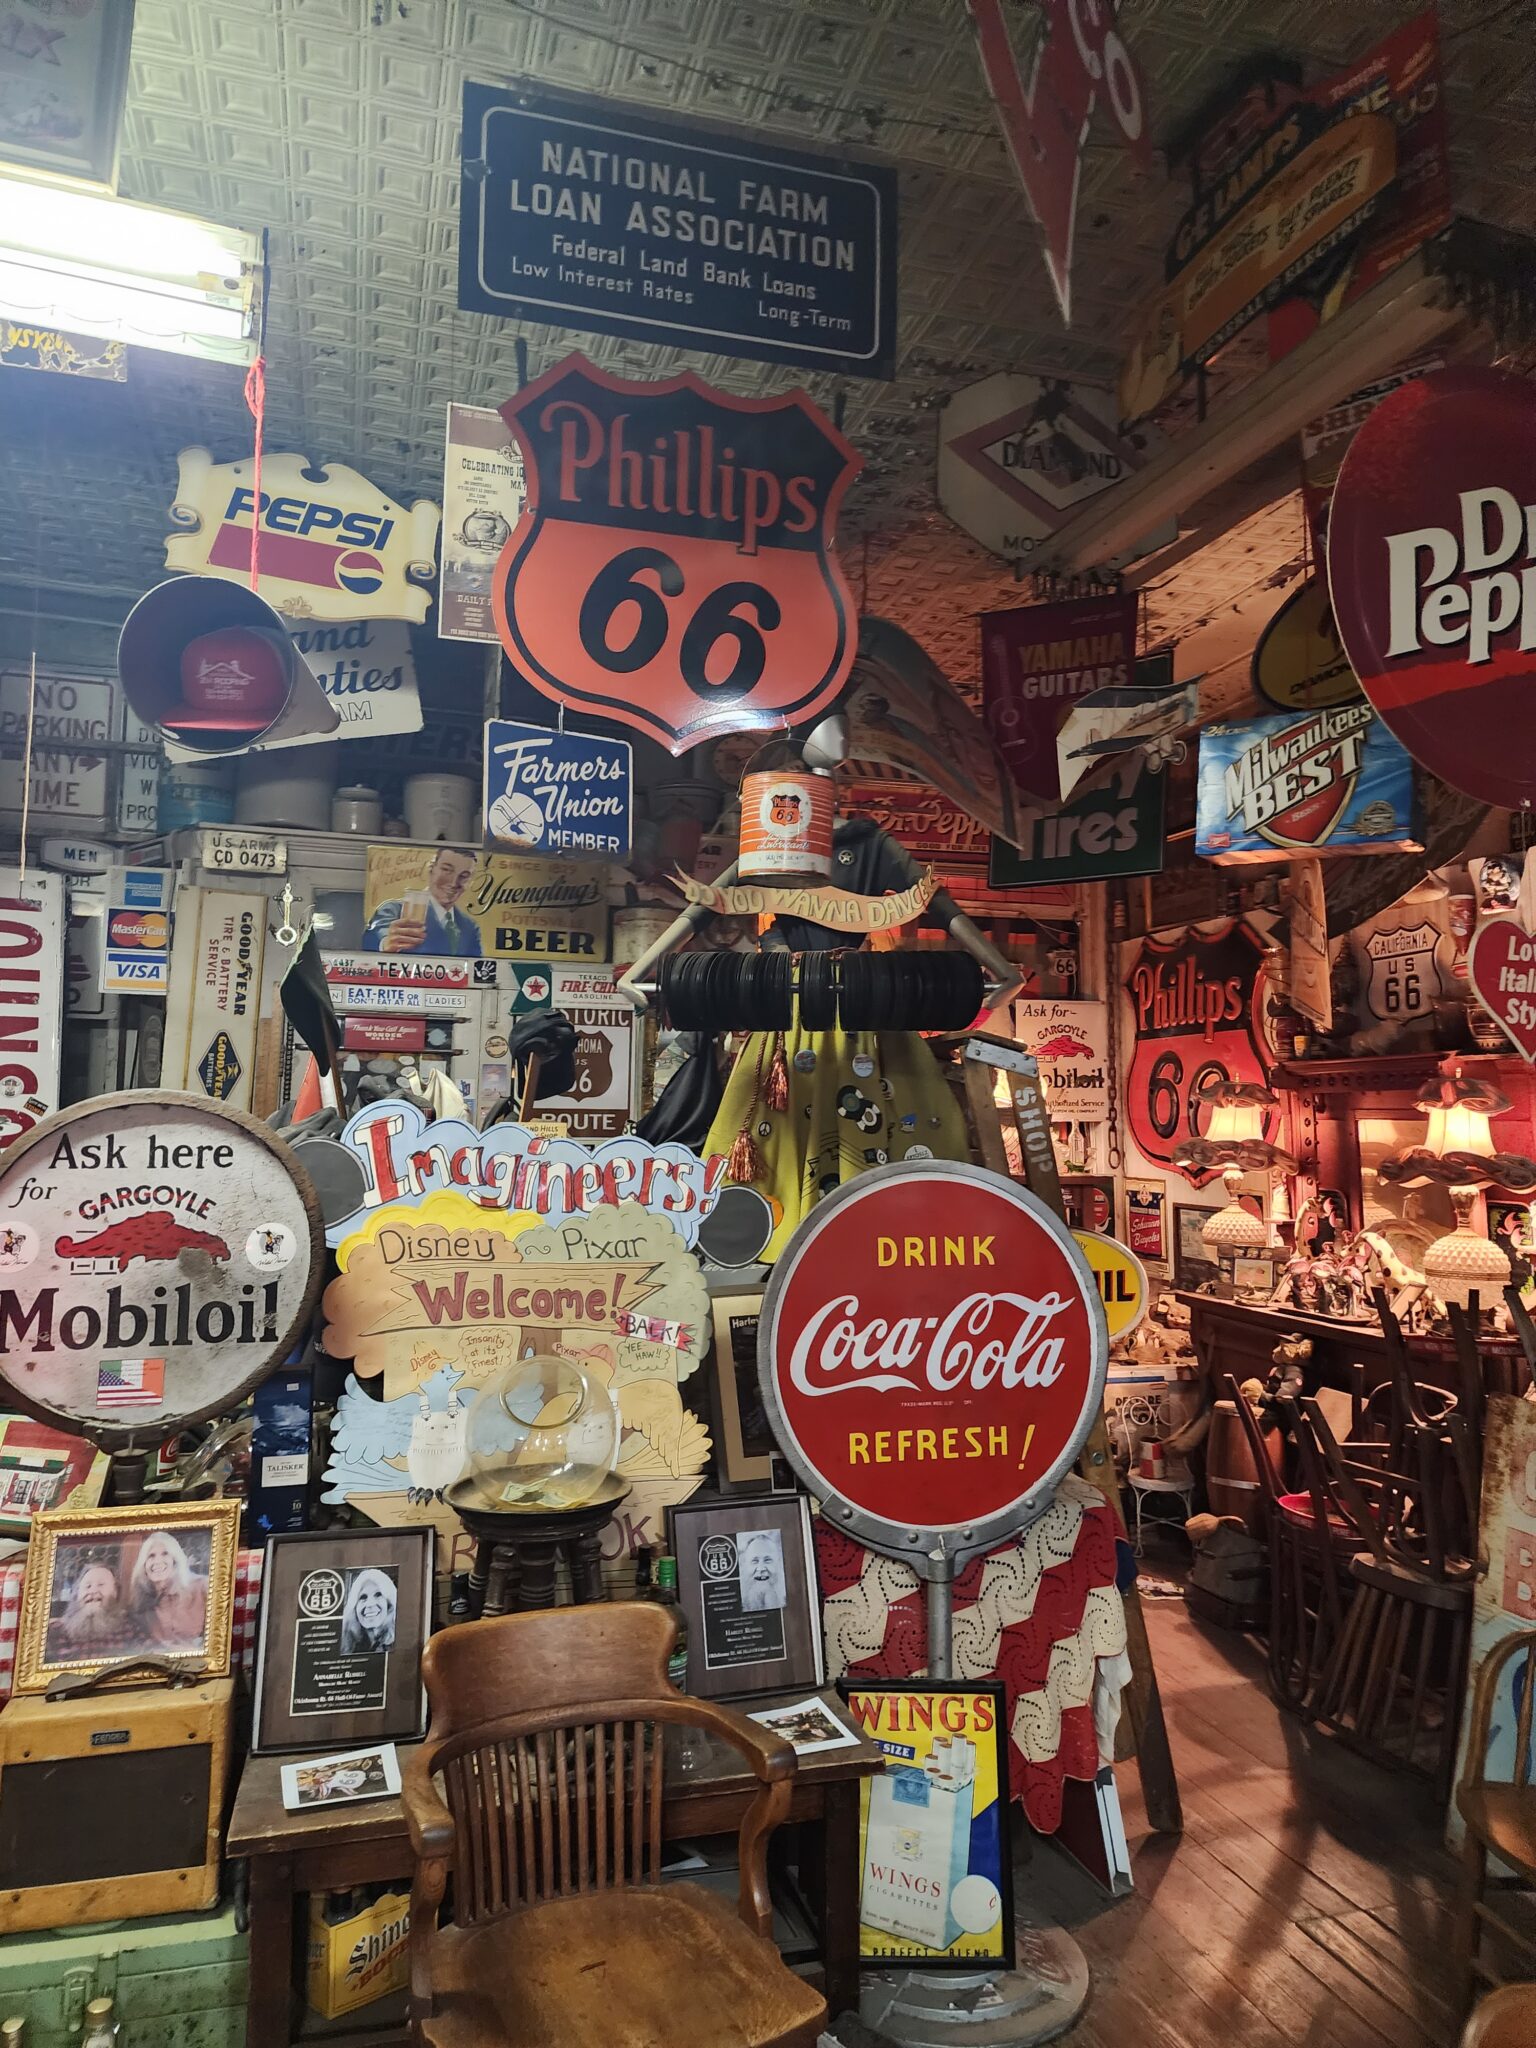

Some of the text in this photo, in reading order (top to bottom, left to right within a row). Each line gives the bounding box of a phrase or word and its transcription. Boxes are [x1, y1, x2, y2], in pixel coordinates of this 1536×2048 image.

[542, 140, 828, 226] NATIONAL FARM
[510, 179, 856, 273] LOAN ASSOCIATION
[552, 234, 817, 301] Federal Land Bank Loans
[512, 257, 852, 332] Low Interest Rates Long-Term
[540, 400, 818, 556] Phillips
[225, 487, 394, 551] PEPSI
[579, 546, 781, 706] 66
[1018, 632, 1124, 673] YAMAHA
[1022, 664, 1128, 699] GUITARS
[33, 685, 77, 711] NO
[1, 712, 107, 740] PARKING
[494, 738, 625, 799] Farmers
[1244, 730, 1367, 832] BEST
[19, 778, 80, 807] TIME
[533, 784, 623, 826] Union
[777, 809, 793, 821] 66
[64, 847, 97, 862] MEN
[548, 829, 620, 853] MEMBER
[214, 849, 275, 868] CD 0473
[500, 860, 540, 872] SINCE
[720, 886, 764, 913] YOU
[773, 888, 861, 922] WANNA
[224, 916, 235, 944] TIRE
[495, 927, 596, 955] BEER
[1374, 933, 1428, 953] CALIFORNIA
[116, 963, 160, 980] VISA
[206, 939, 219, 986] SERVICE
[378, 962, 446, 980] TEXACO
[1056, 959, 1074, 974] 66
[217, 958, 234, 1012] BATTERY
[348, 988, 405, 1000] EAT-RITE
[1133, 953, 1242, 1043] Phillips
[1385, 974, 1420, 1013] 66
[429, 997, 462, 1005] LADIES
[1023, 1004, 1047, 1017] Ask
[1037, 1024, 1088, 1040] GARGOYLE
[1081, 1099, 1105, 1108] Service
[1014, 1086, 1054, 1175] SHOP
[49, 1132, 234, 1169] Ask here
[354, 1114, 729, 1215] Imagineers!
[8, 1177, 58, 1208] for
[79, 1184, 217, 1221] GARGOYLE
[379, 1227, 648, 1264] Disney Pixar
[877, 1235, 996, 1268] DRINK
[411, 1271, 627, 1326] Welcome!
[0, 1280, 279, 1353] Mobiloil
[465, 1334, 505, 1349] Insanity
[483, 1347, 496, 1355] its
[555, 1342, 582, 1357] Pixar
[790, 1291, 1075, 1397] Coca-Cola
[410, 1348, 440, 1372] Disney
[267, 1463, 304, 1472] TALISKER
[711, 1558, 728, 1571] 66
[311, 1594, 331, 1608] 66
[849, 1695, 994, 1732] WINGS
[882, 1743, 911, 1757] SIZE
[870, 1862, 941, 1898] WINGS
[869, 1884, 938, 1911] CIGARETTES
